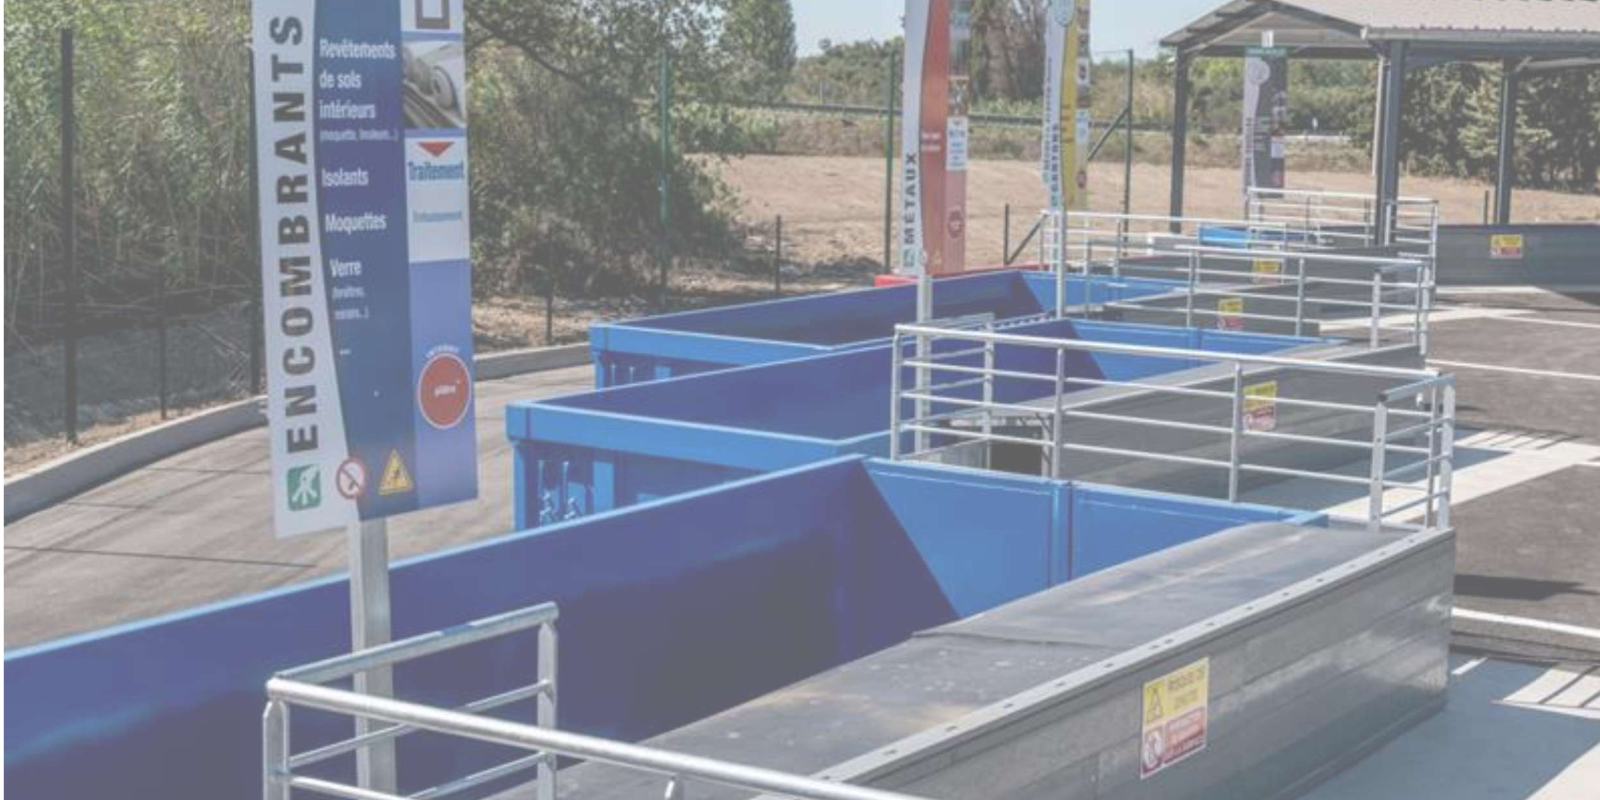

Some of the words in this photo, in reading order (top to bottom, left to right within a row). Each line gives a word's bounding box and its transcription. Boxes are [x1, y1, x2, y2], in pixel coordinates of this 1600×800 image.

[319, 38, 396, 60] Revêtements
[319, 70, 335, 88] de
[337, 70, 362, 88] sols
[319, 99, 376, 119] intérieurs
[321, 167, 369, 187] Isolants
[408, 160, 465, 182] Traitement
[902, 152, 918, 245] MÉTAUX
[270, 16, 318, 453] ENCOMBRANTS
[325, 212, 387, 235] Moquettes
[330, 258, 362, 278] Verre
